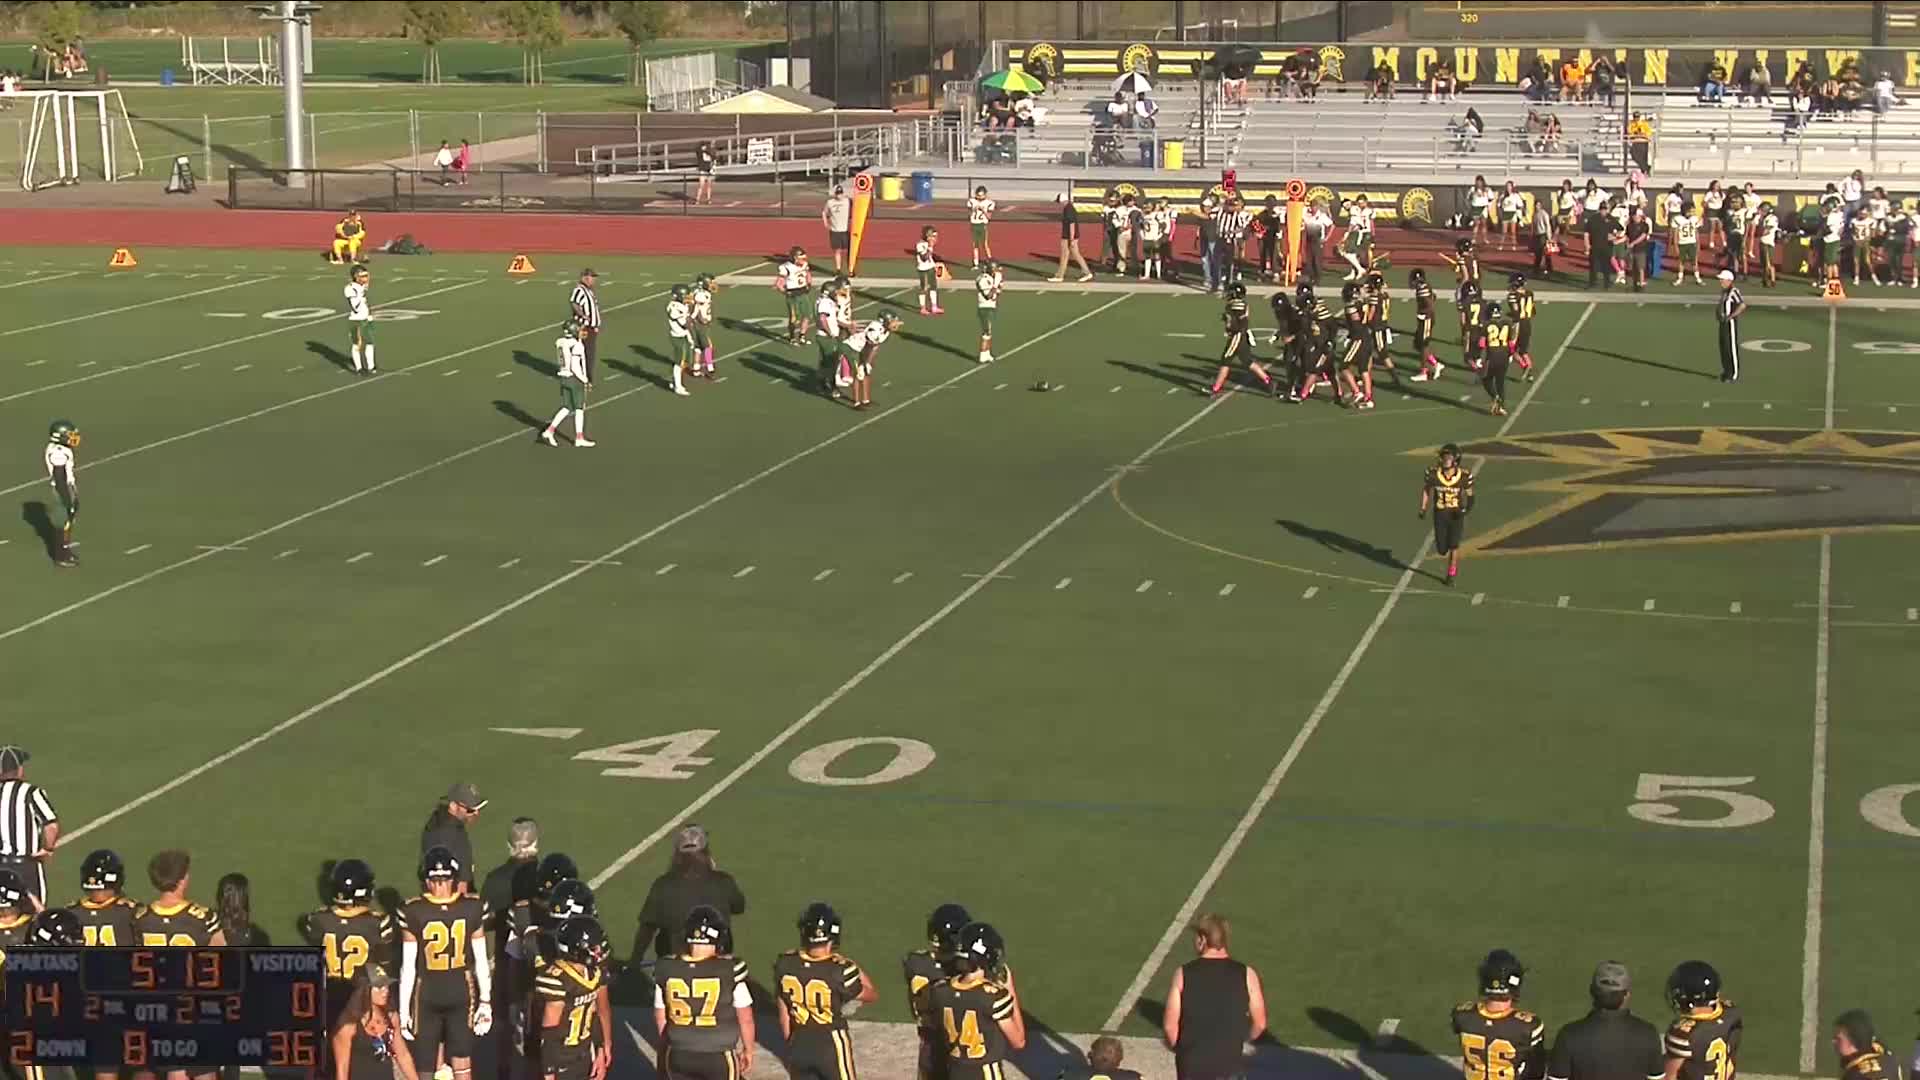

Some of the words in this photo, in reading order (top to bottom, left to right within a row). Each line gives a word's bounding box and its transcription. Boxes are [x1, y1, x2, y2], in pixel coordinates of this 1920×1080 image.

[1461, 13, 1478, 23] 320
[1829, 283, 1840, 295] 50
[1487, 324, 1510, 347] 24
[422, 918, 466, 971] 21
[666, 977, 720, 1027] 67
[780, 974, 833, 1025] 30
[1461, 1032, 1516, 1080] 56
